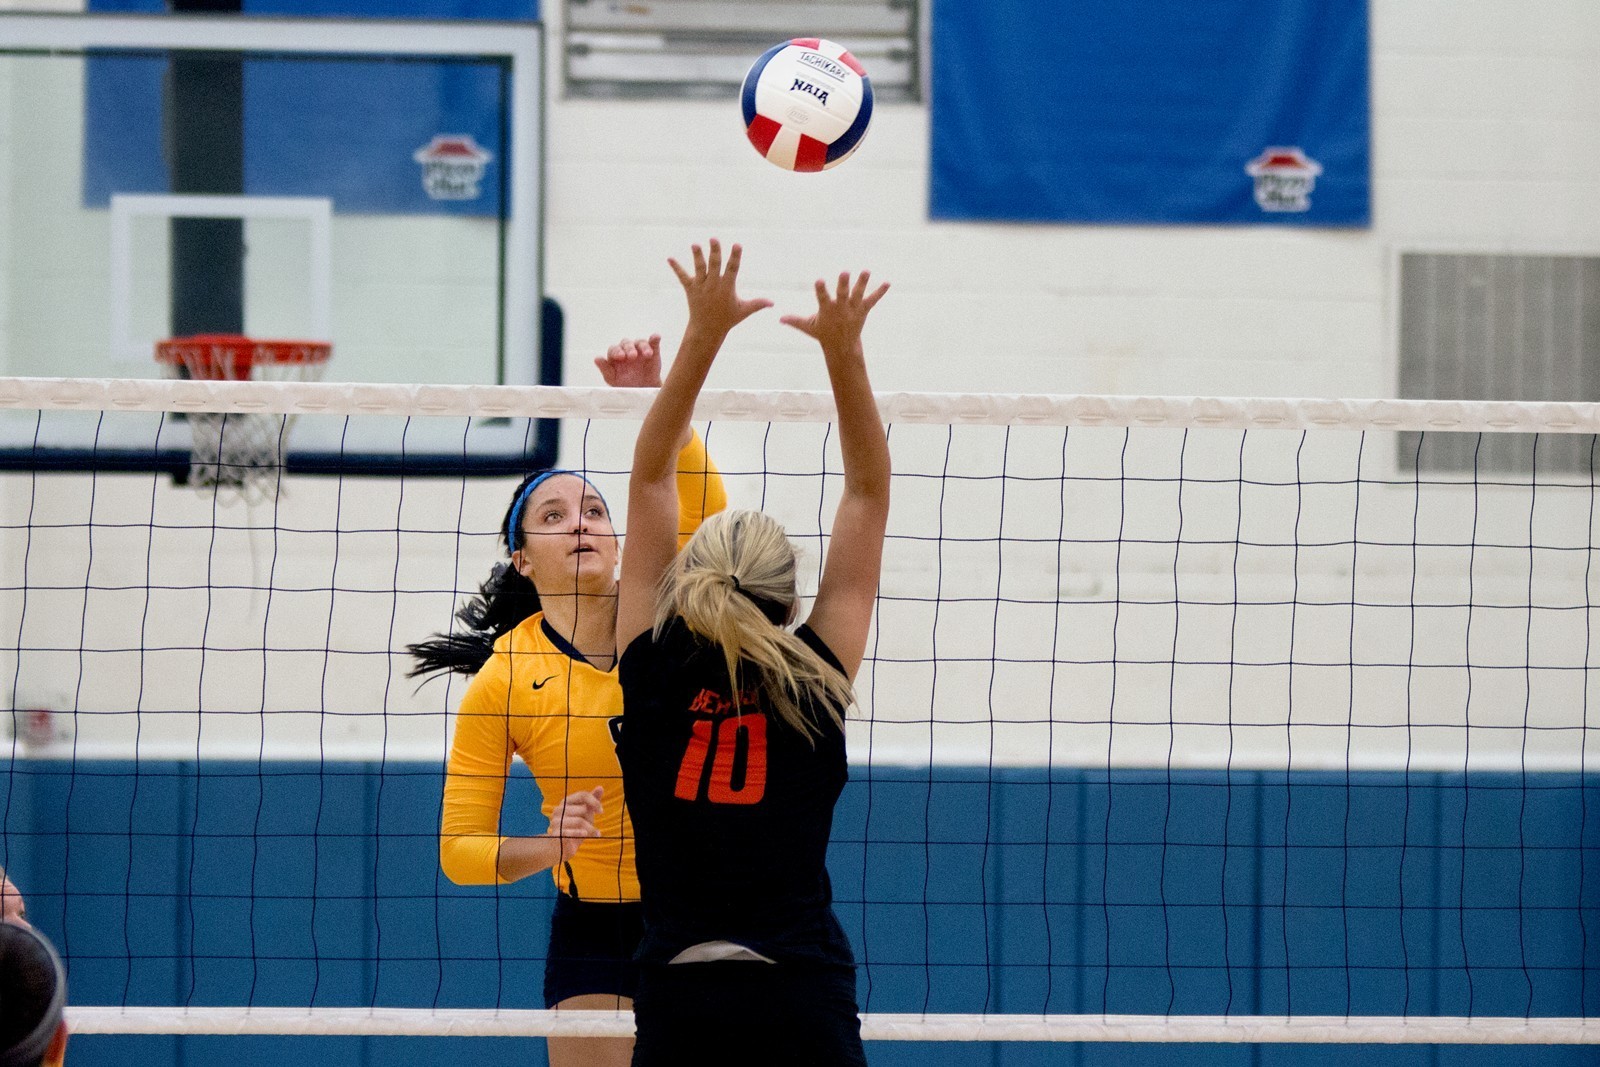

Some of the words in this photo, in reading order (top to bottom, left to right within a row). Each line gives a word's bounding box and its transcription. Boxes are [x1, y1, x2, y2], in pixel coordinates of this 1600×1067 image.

[799, 52, 846, 79] TACHIKARA
[790, 78, 829, 106] NAIA
[674, 713, 767, 805] 10
